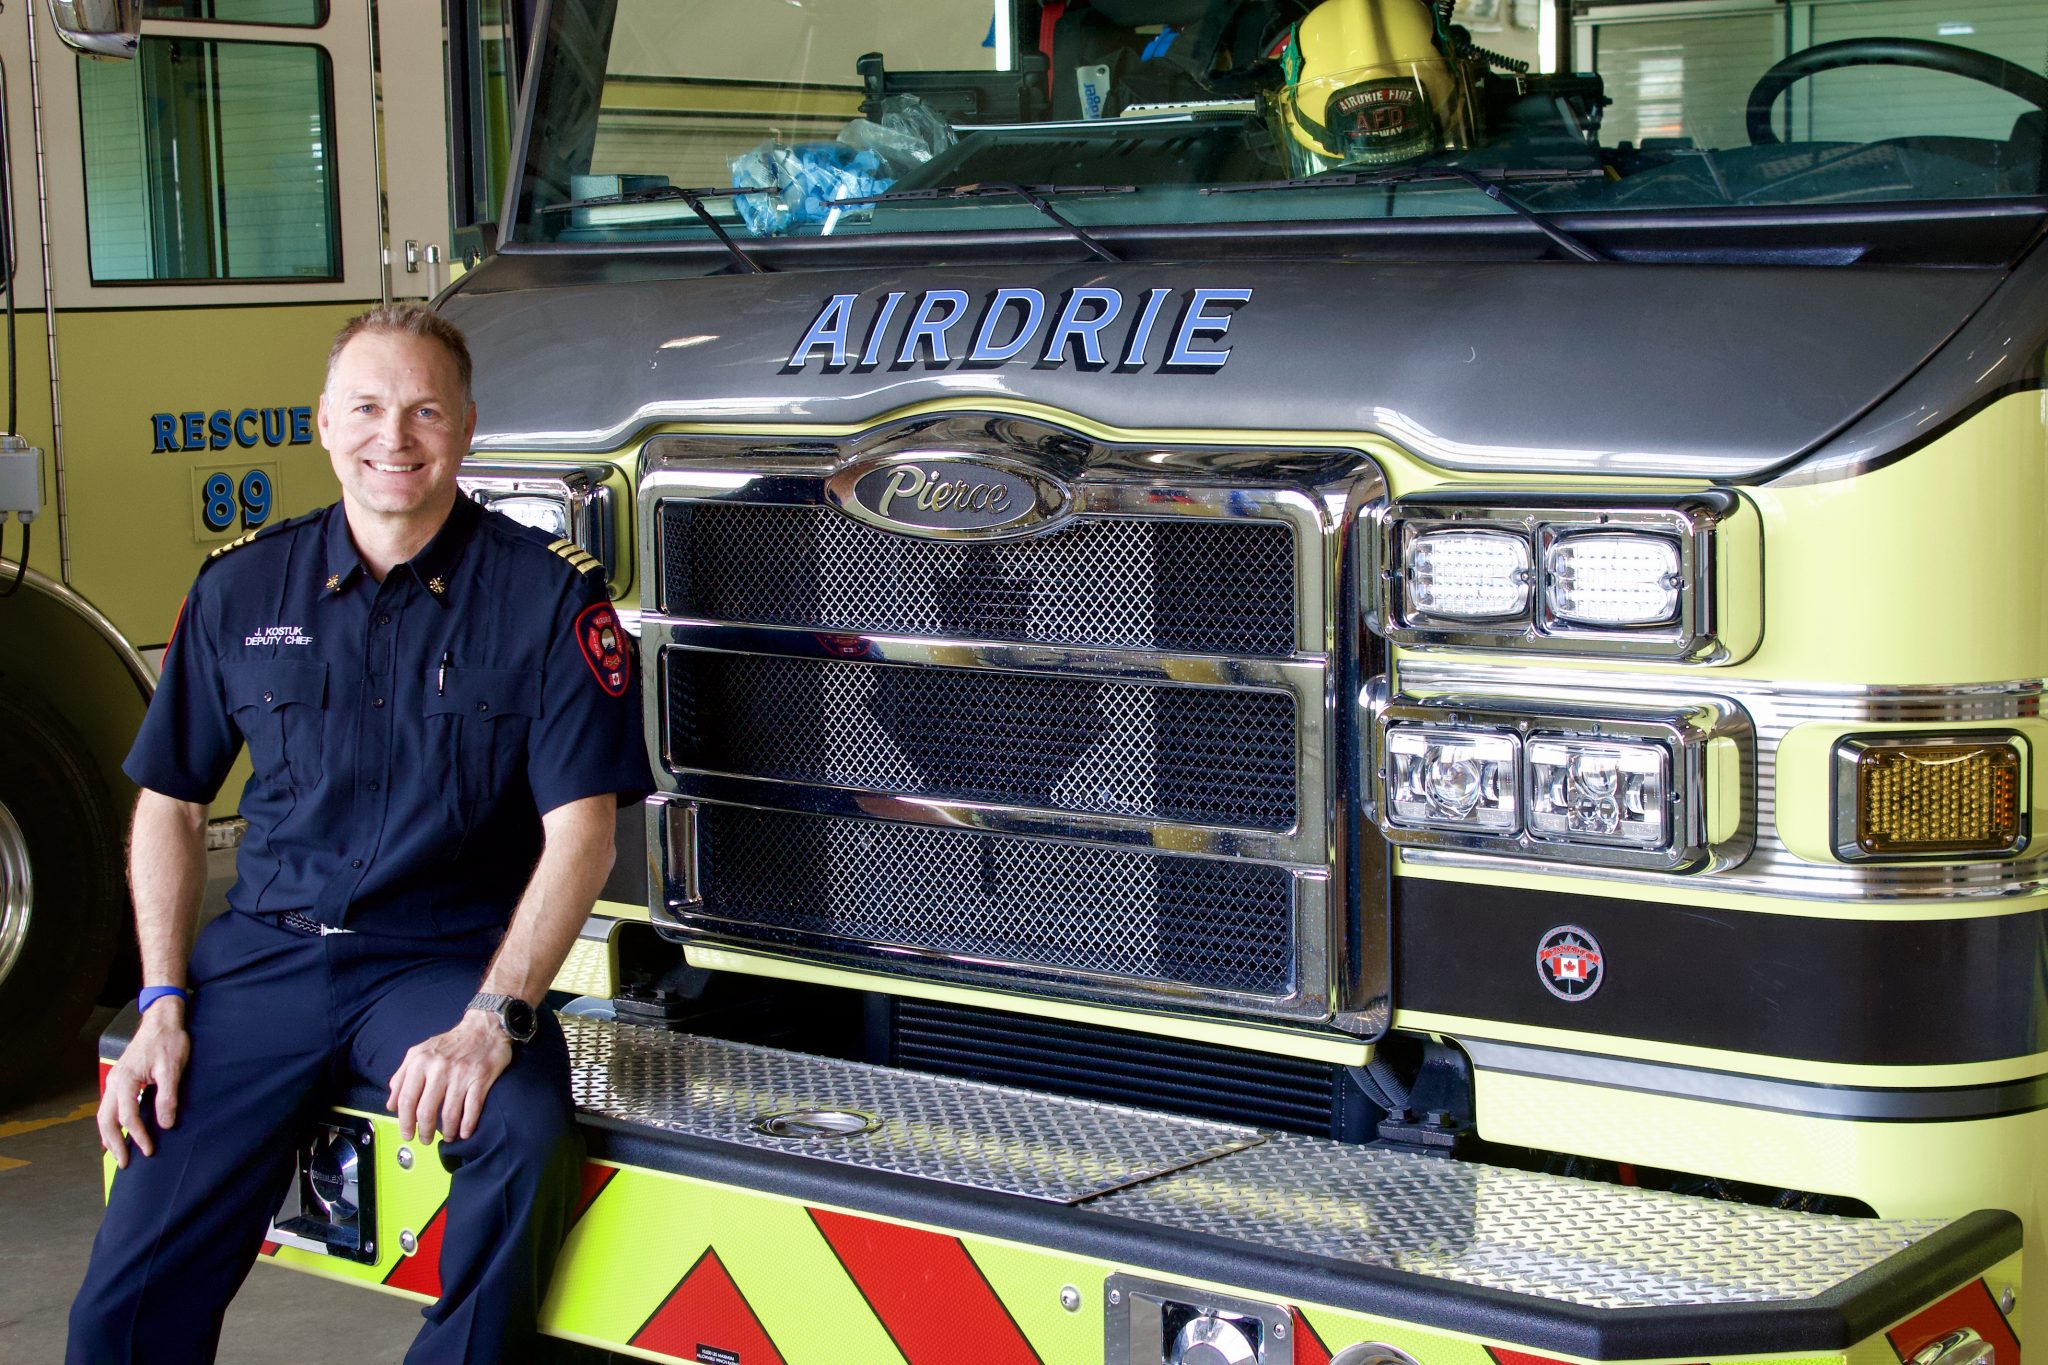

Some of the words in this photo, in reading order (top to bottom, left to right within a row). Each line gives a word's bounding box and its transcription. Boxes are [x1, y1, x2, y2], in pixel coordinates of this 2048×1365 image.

[1339, 90, 1384, 111] AIRDRIE
[1388, 89, 1413, 102] FIRE
[779, 287, 1253, 373] AIRDRIE
[151, 406, 313, 453] RESCUE
[202, 469, 272, 532] 89
[879, 464, 1012, 517] Pierce
[245, 636, 282, 646] DEPUTY
[284, 636, 313, 645] CHIEF
[254, 627, 262, 637] J.
[265, 626, 303, 636] KOSTUK
